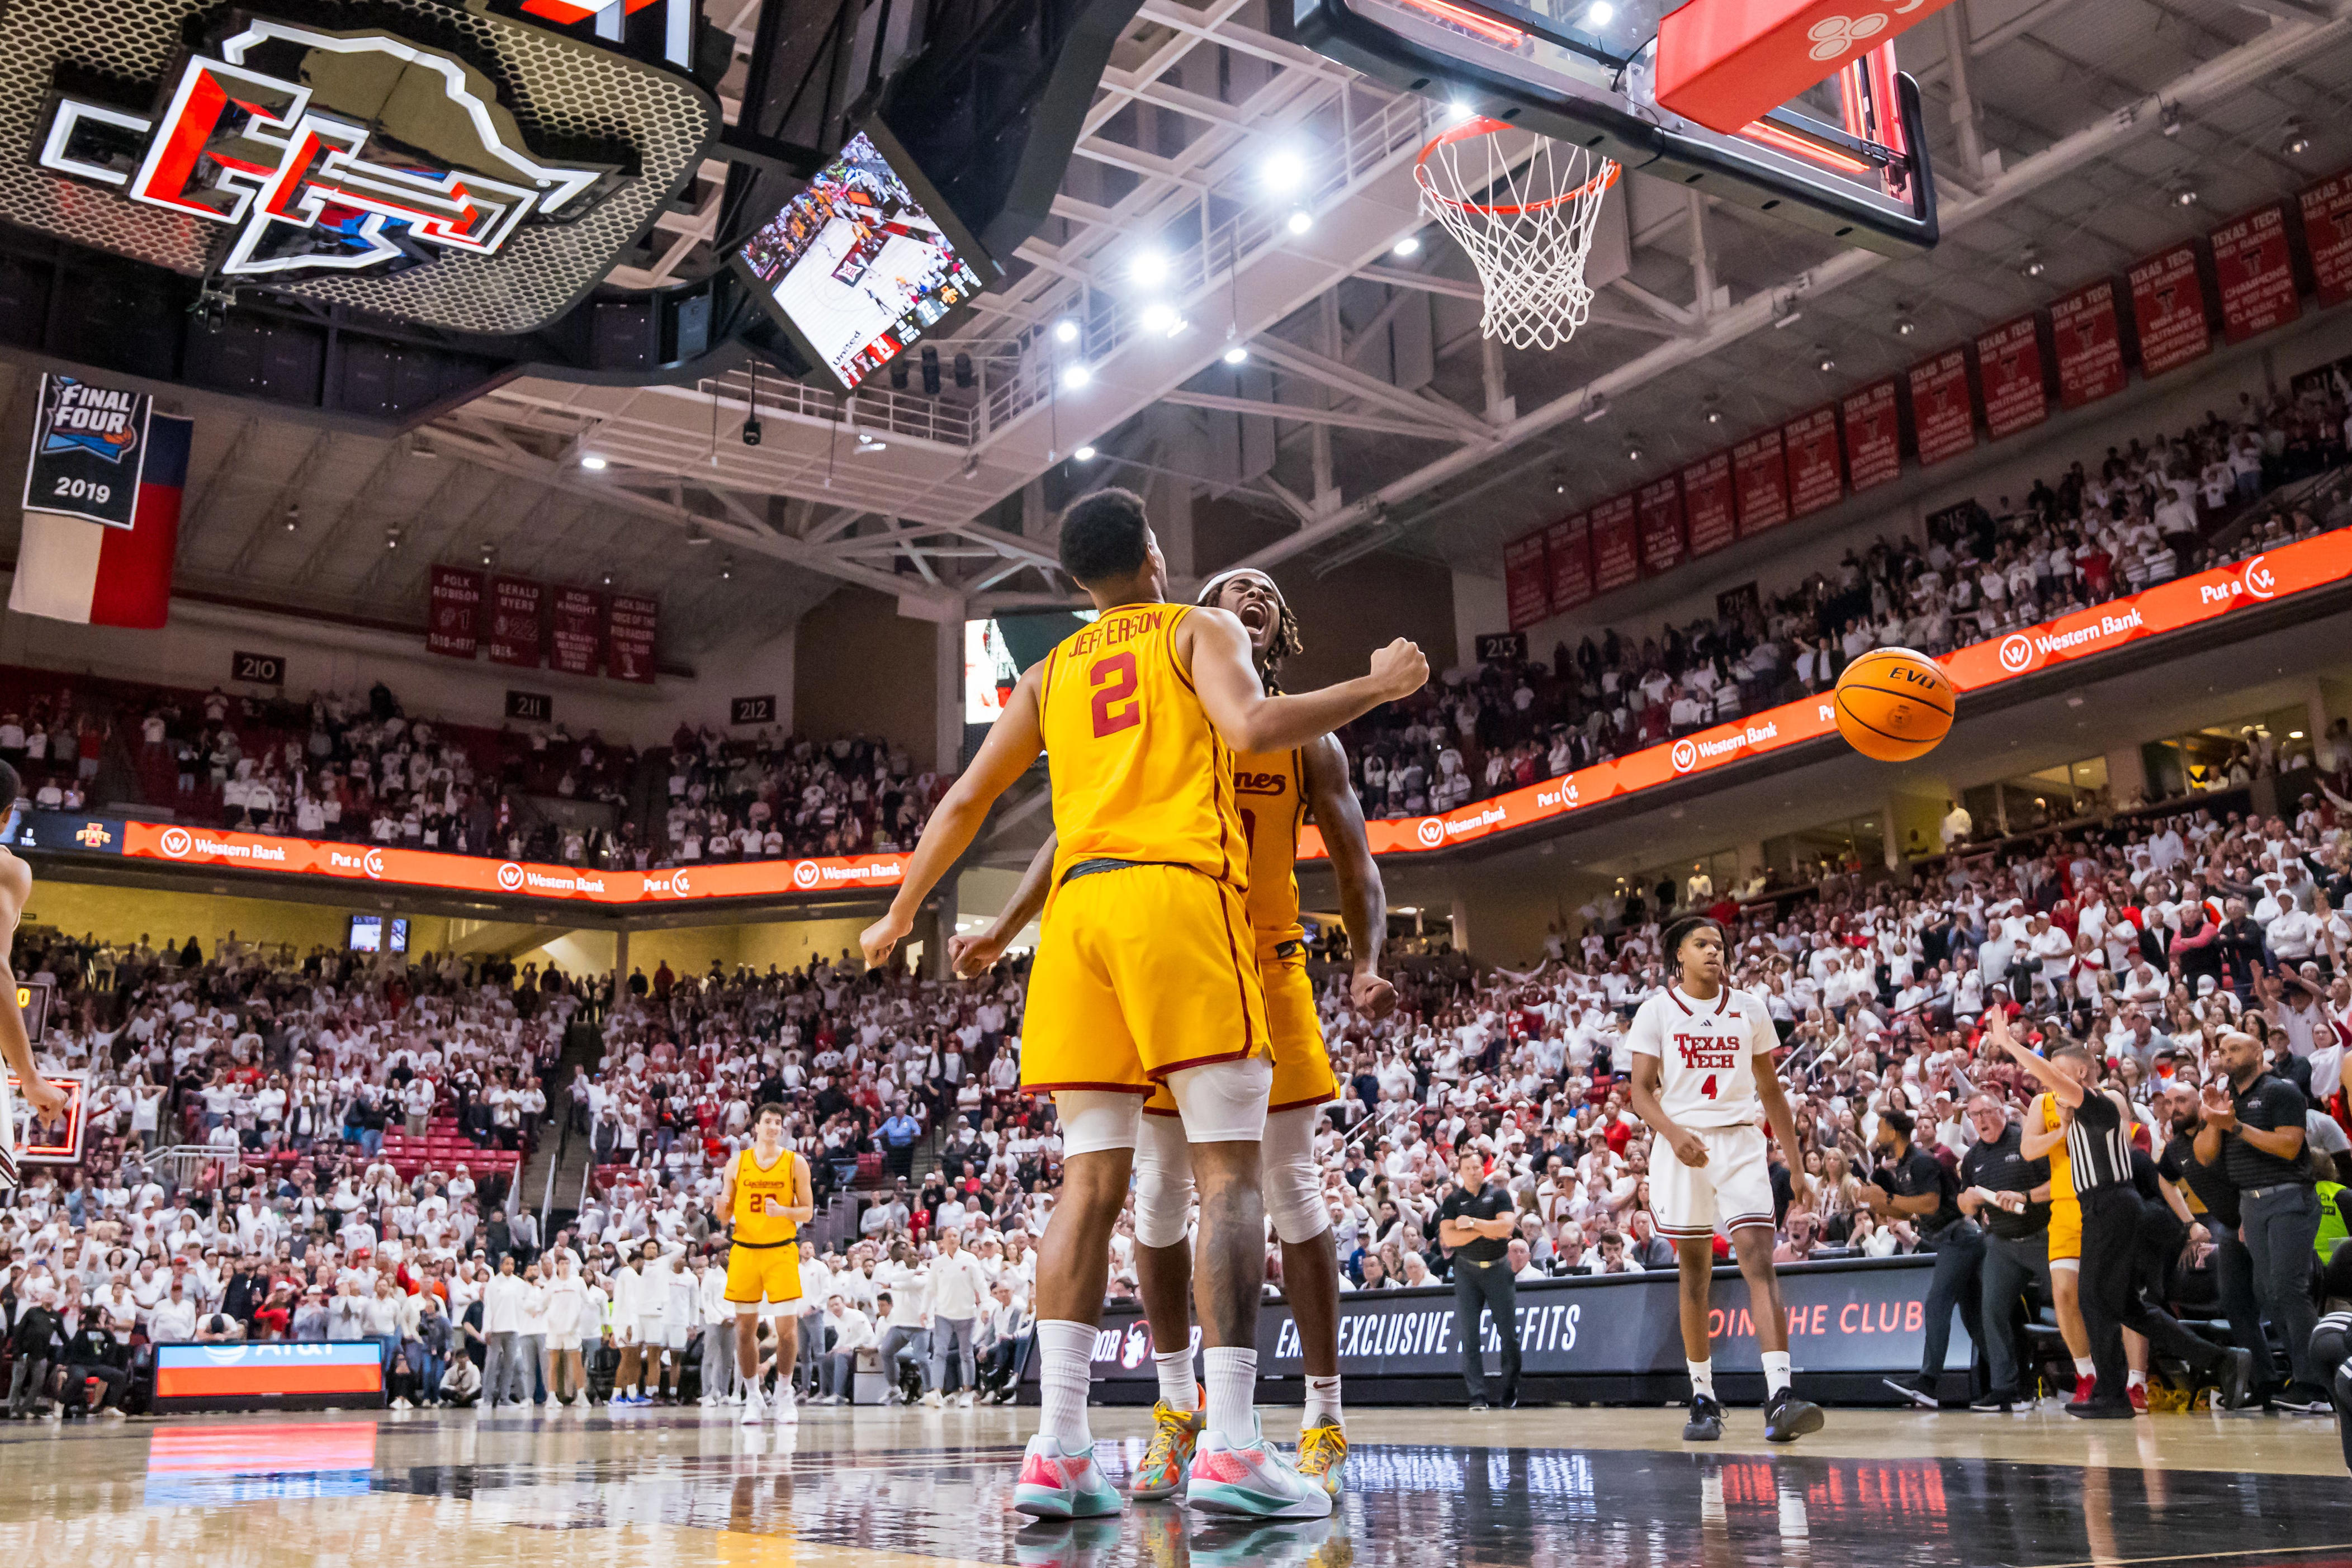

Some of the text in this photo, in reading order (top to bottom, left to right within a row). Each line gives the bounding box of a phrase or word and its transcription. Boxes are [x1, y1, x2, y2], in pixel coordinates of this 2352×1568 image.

[2211, 206, 2281, 247] TEXAS TECH
[2128, 260, 2163, 285] TEXAS
[2050, 282, 2112, 320] TEXAS TECH
[62, 385, 131, 412] FINAL
[55, 406, 127, 434] FOUR
[54, 477, 111, 503] 2019
[443, 574, 470, 588] POLK
[498, 582, 539, 600] GERALD
[433, 585, 479, 602] ROBISON
[566, 591, 589, 604] BOB
[2200, 582, 2230, 604] Put
[2231, 580, 2242, 595] a
[500, 596, 535, 613] MYERS
[556, 600, 598, 615] KNIGHT
[1068, 611, 1163, 658] JEFFERSON
[2035, 624, 2100, 655] Western
[2101, 607, 2143, 636] Bank
[1486, 636, 1517, 658] 213
[241, 658, 276, 679] 210
[1090, 651, 1141, 738] 2
[518, 697, 541, 716] 211
[740, 701, 768, 720] 212
[1819, 705, 1835, 721] Pu
[1698, 735, 1747, 758] Western
[1747, 721, 1778, 744] Bank
[1537, 792, 1554, 808] Put
[1554, 791, 1561, 803] a
[1445, 816, 1482, 835] Western
[1482, 806, 1506, 825] Bank
[195, 838, 250, 858] Western
[253, 844, 286, 861] Bank
[331, 852, 352, 867] Put
[353, 857, 361, 868] a
[822, 866, 870, 880] Western
[871, 862, 901, 877] Bank
[527, 872, 574, 890] Western
[576, 877, 604, 893] Bank
[643, 879, 661, 892] Put
[662, 880, 670, 890] a
[1673, 1033, 1740, 1054] TEXAS
[1680, 1049, 1735, 1069] TECH
[1701, 1074, 1718, 1100] 4
[1709, 1301, 1923, 1337] OIN HE CLUB
[1275, 1318, 1304, 1358] EA
[1338, 1310, 1455, 1357] EXCLUSIVE
